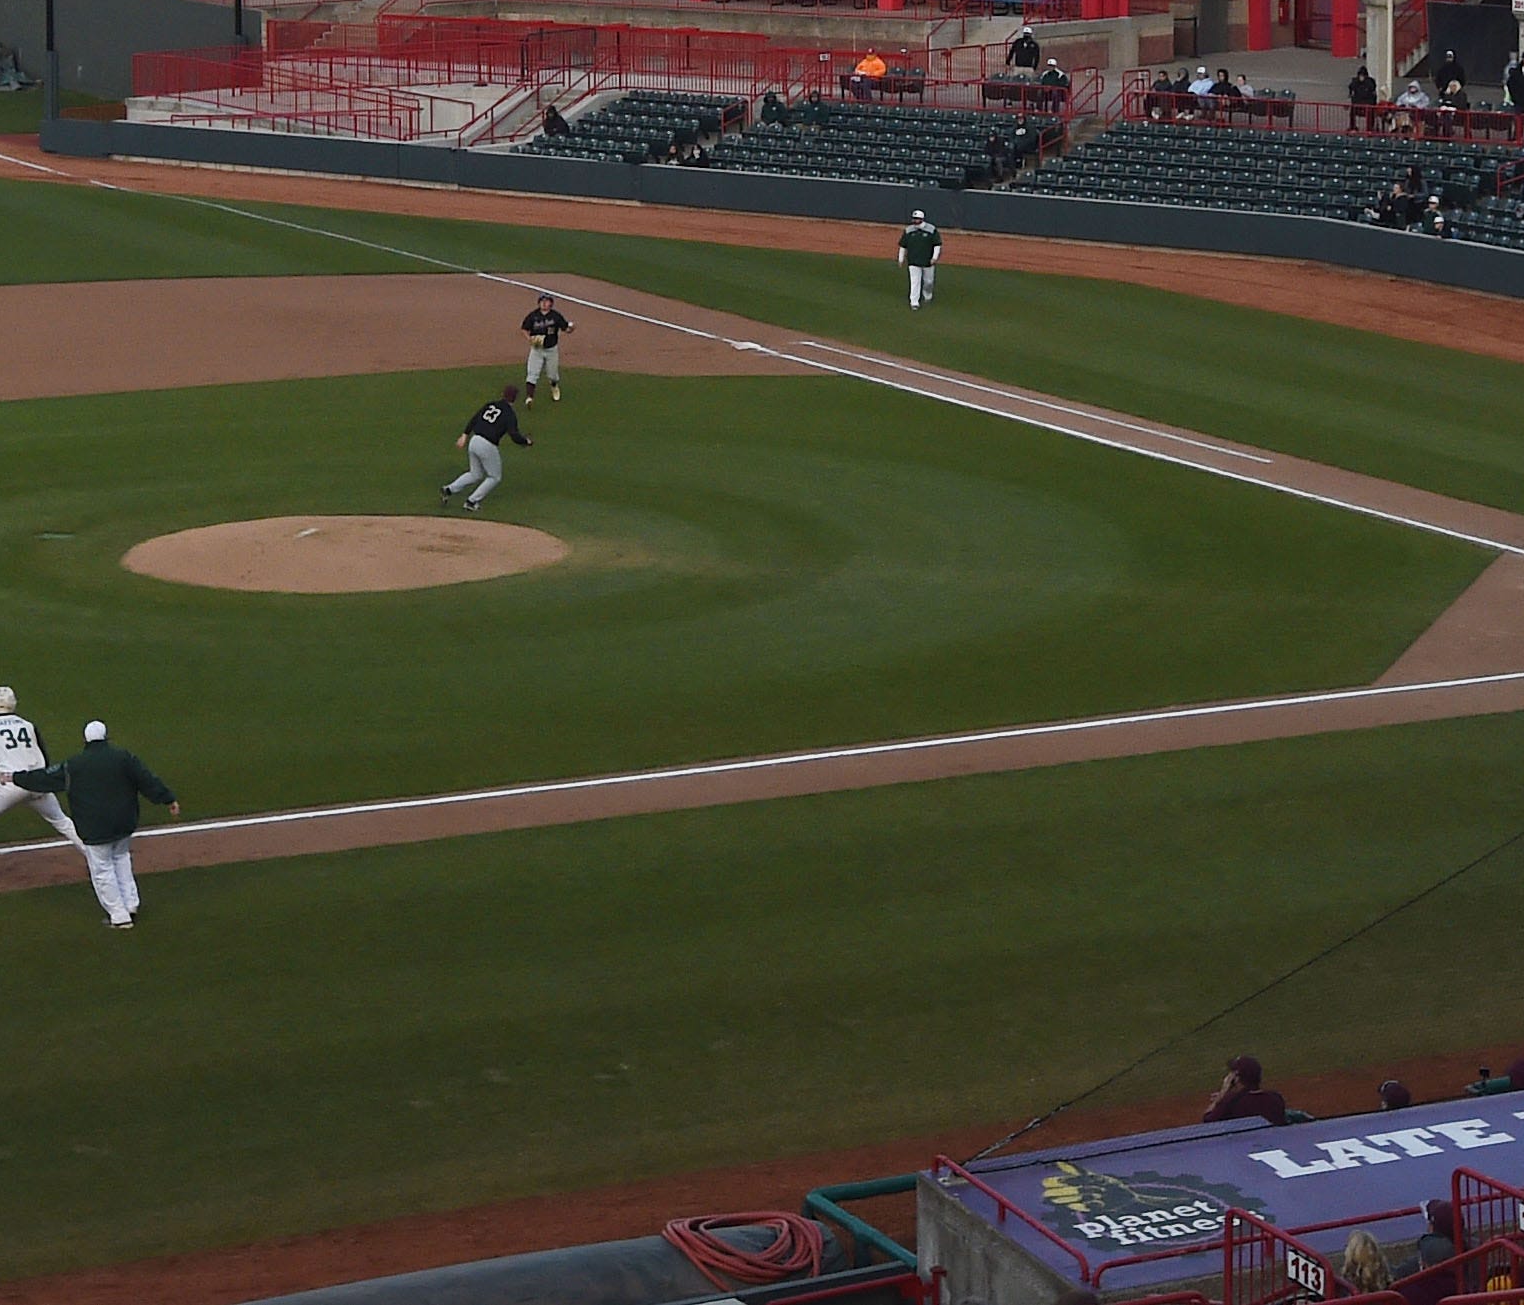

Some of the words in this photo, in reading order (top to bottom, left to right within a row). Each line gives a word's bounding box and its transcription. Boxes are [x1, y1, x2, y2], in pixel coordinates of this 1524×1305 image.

[482, 404, 502, 424] 23
[0, 727, 32, 750] 34
[1248, 1118, 1516, 1179] LATE
[1073, 1199, 1218, 1240] planet
[1290, 1255, 1322, 1293] 113
